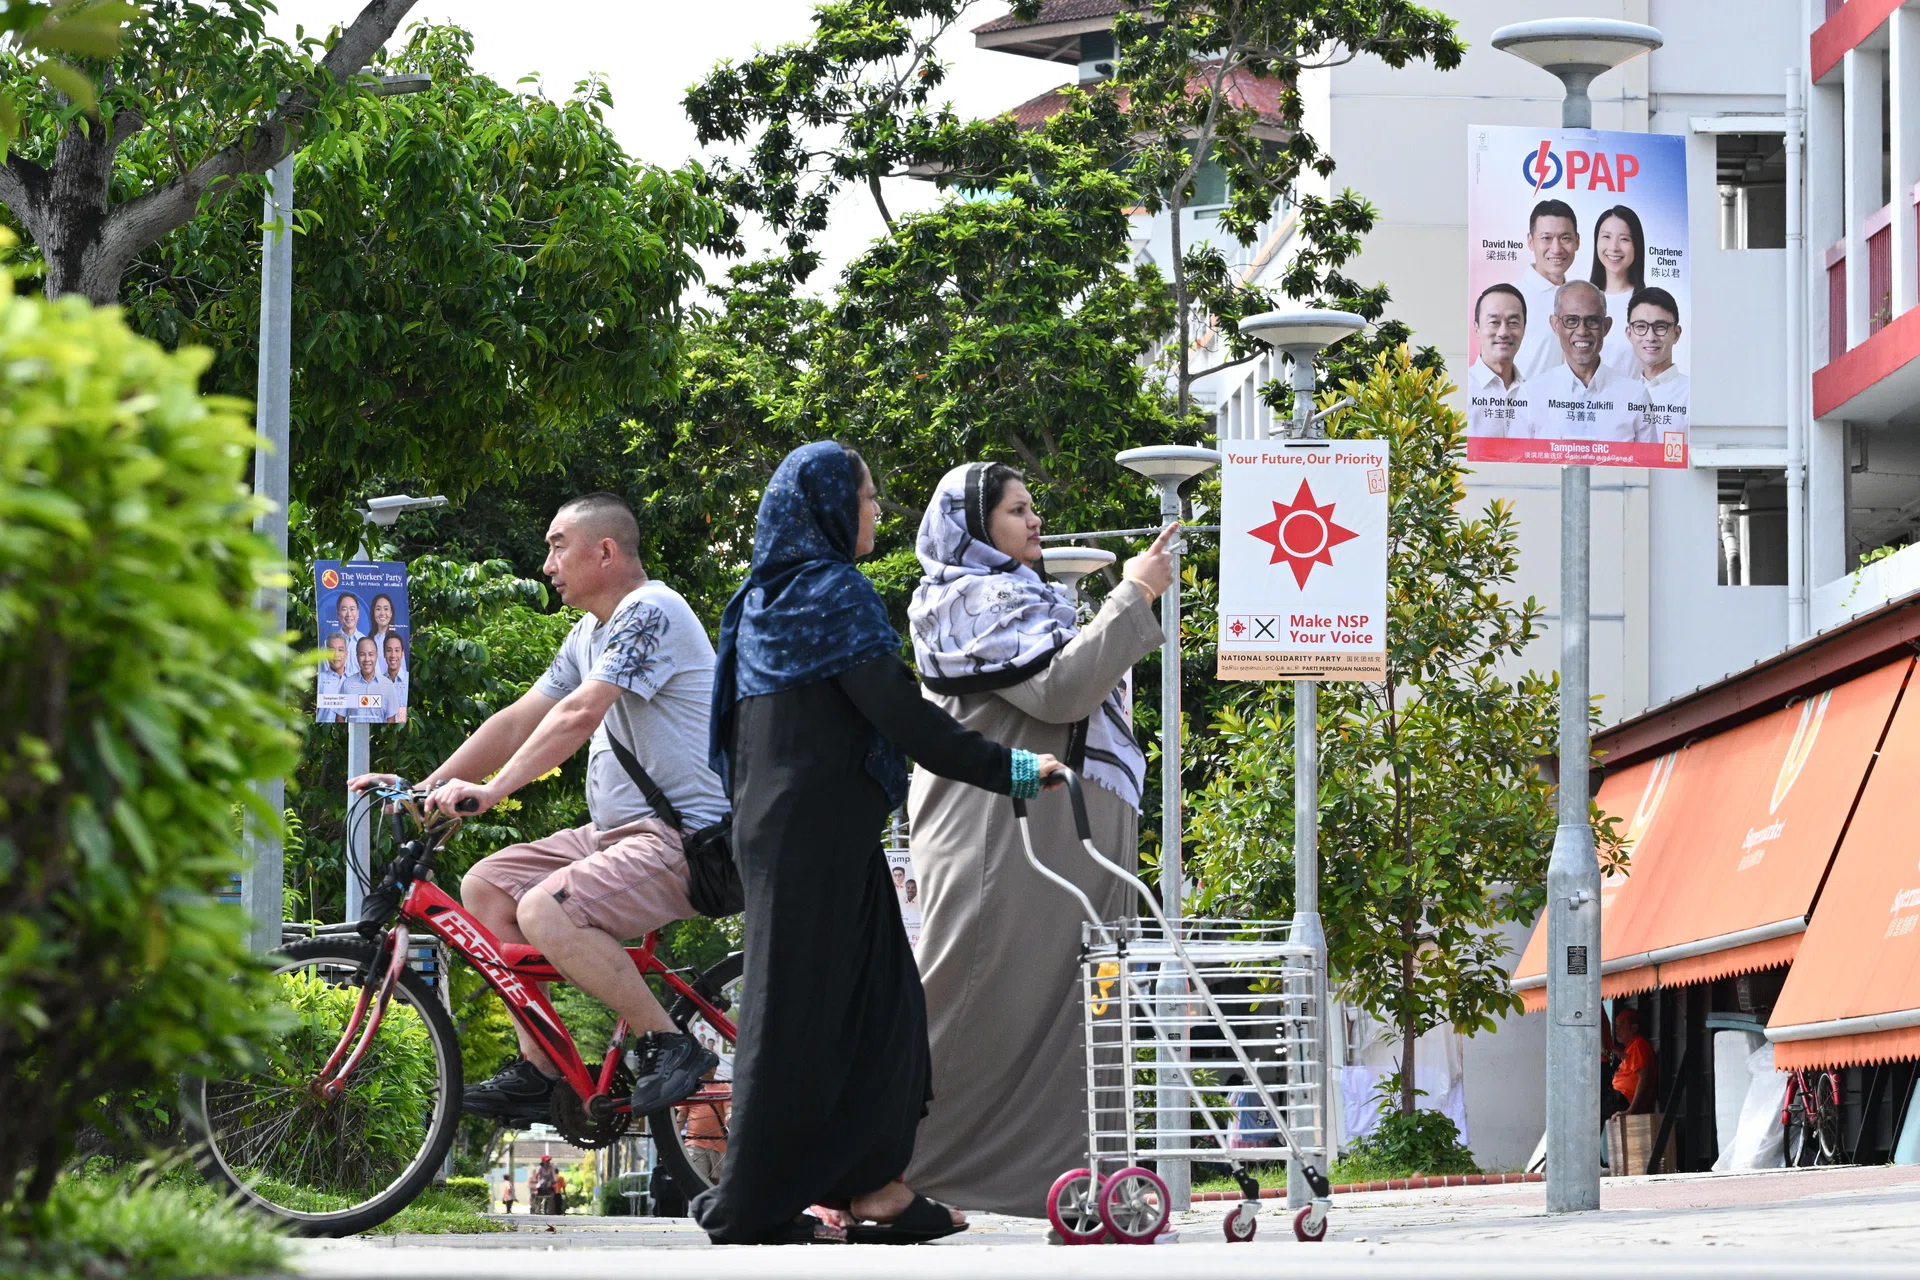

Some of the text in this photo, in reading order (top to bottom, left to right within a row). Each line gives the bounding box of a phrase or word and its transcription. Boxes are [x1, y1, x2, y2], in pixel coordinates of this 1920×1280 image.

[1566, 150, 1639, 193] PAP
[1482, 239, 1524, 250] David Neo
[1486, 250, 1518, 261] 梁振伟
[1648, 246, 1683, 257] Charlene
[1657, 256, 1677, 266] Chen
[1651, 267, 1680, 278] 陈以君
[1471, 396, 1528, 407] Koh Poh Koon
[1548, 399, 1614, 411] Masagos Zulkifli
[1627, 402, 1687, 414] Baey Yam Keng
[1484, 408, 1516, 420] 许宝琨
[1565, 411, 1596, 422] 马善高
[1642, 414, 1672, 425] 马炎庆
[1550, 442, 1609, 454] Tampines GRC
[1666, 443, 1682, 458] 02
[1228, 453, 1258, 465] Your
[1335, 453, 1383, 467] Priority
[340, 572, 354, 580] The
[385, 573, 403, 583] Party
[1290, 614, 1369, 628] Make NSP
[1290, 631, 1373, 644] Your Voice
[1221, 654, 1263, 662] NATIONAL
